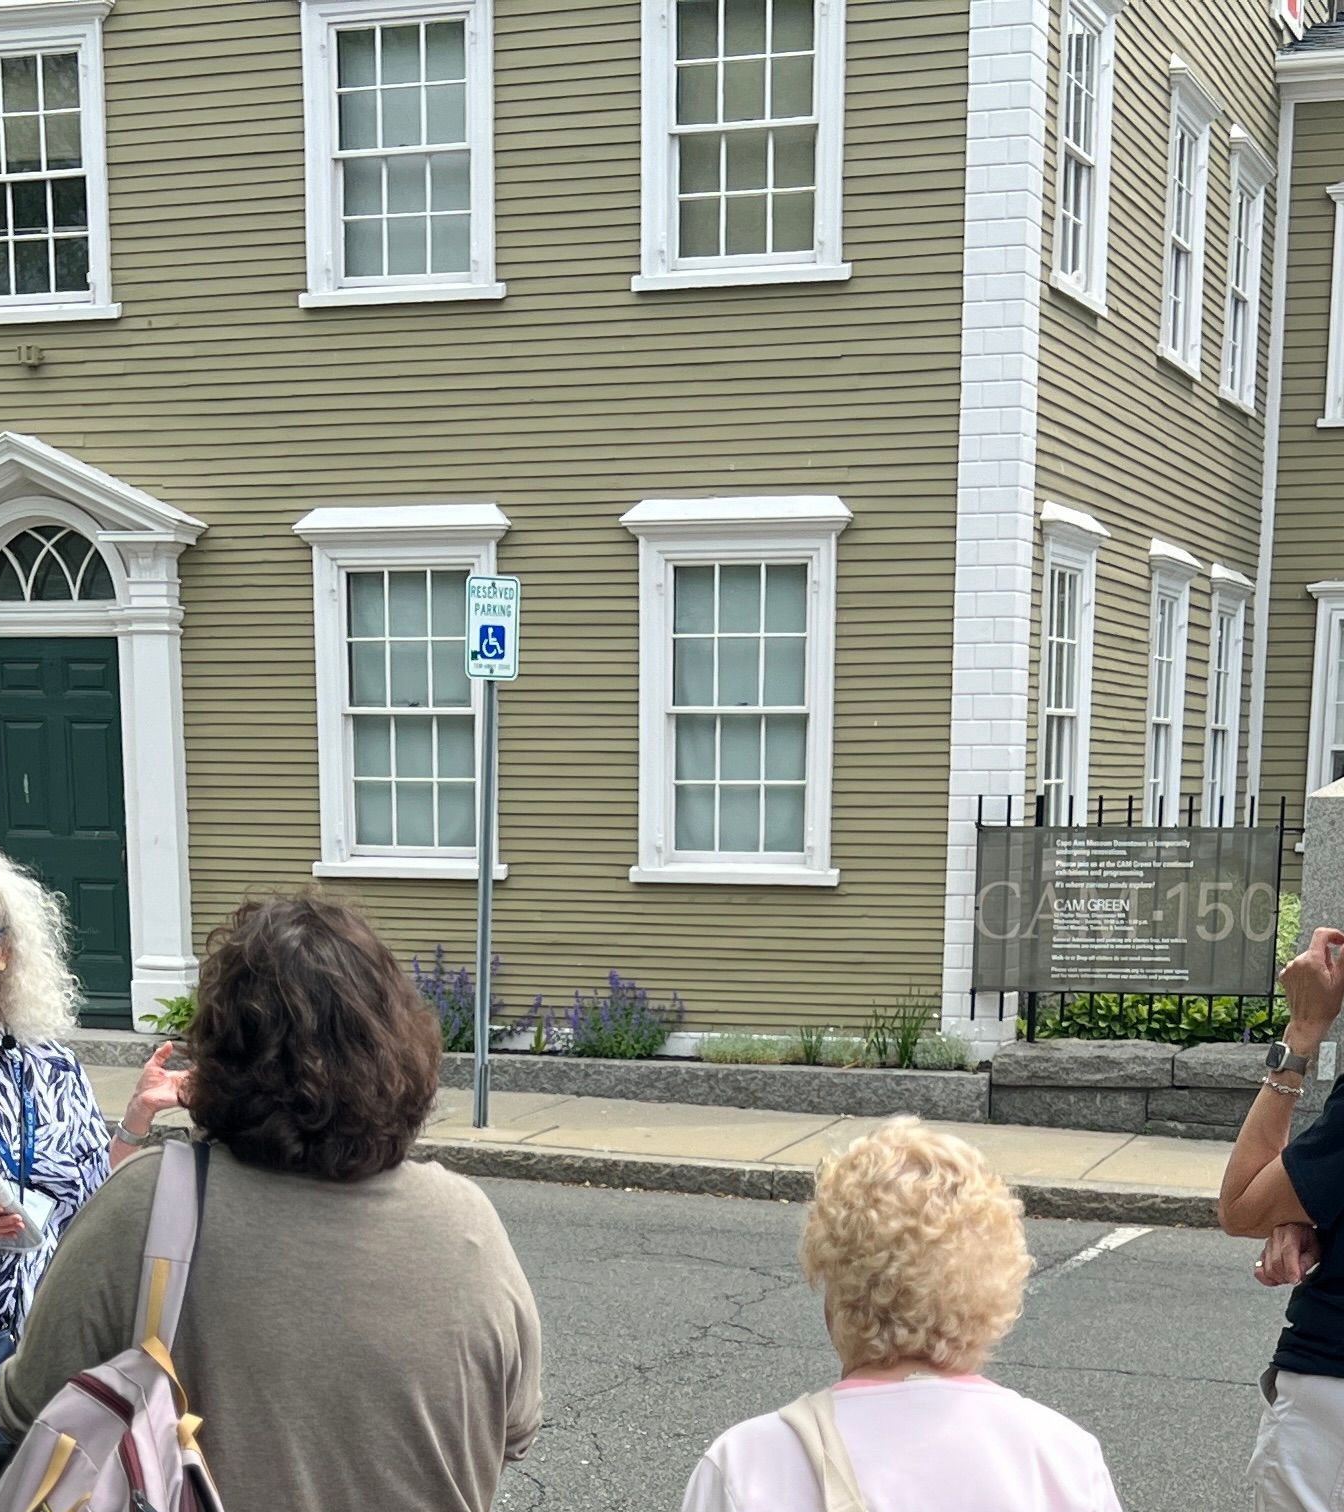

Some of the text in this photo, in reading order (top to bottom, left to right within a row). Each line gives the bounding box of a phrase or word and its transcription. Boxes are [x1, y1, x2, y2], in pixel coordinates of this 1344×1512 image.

[471, 585, 515, 600] RESERVED
[474, 603, 512, 617] PARKING
[1053, 899, 1130, 912] CAM GREEN
